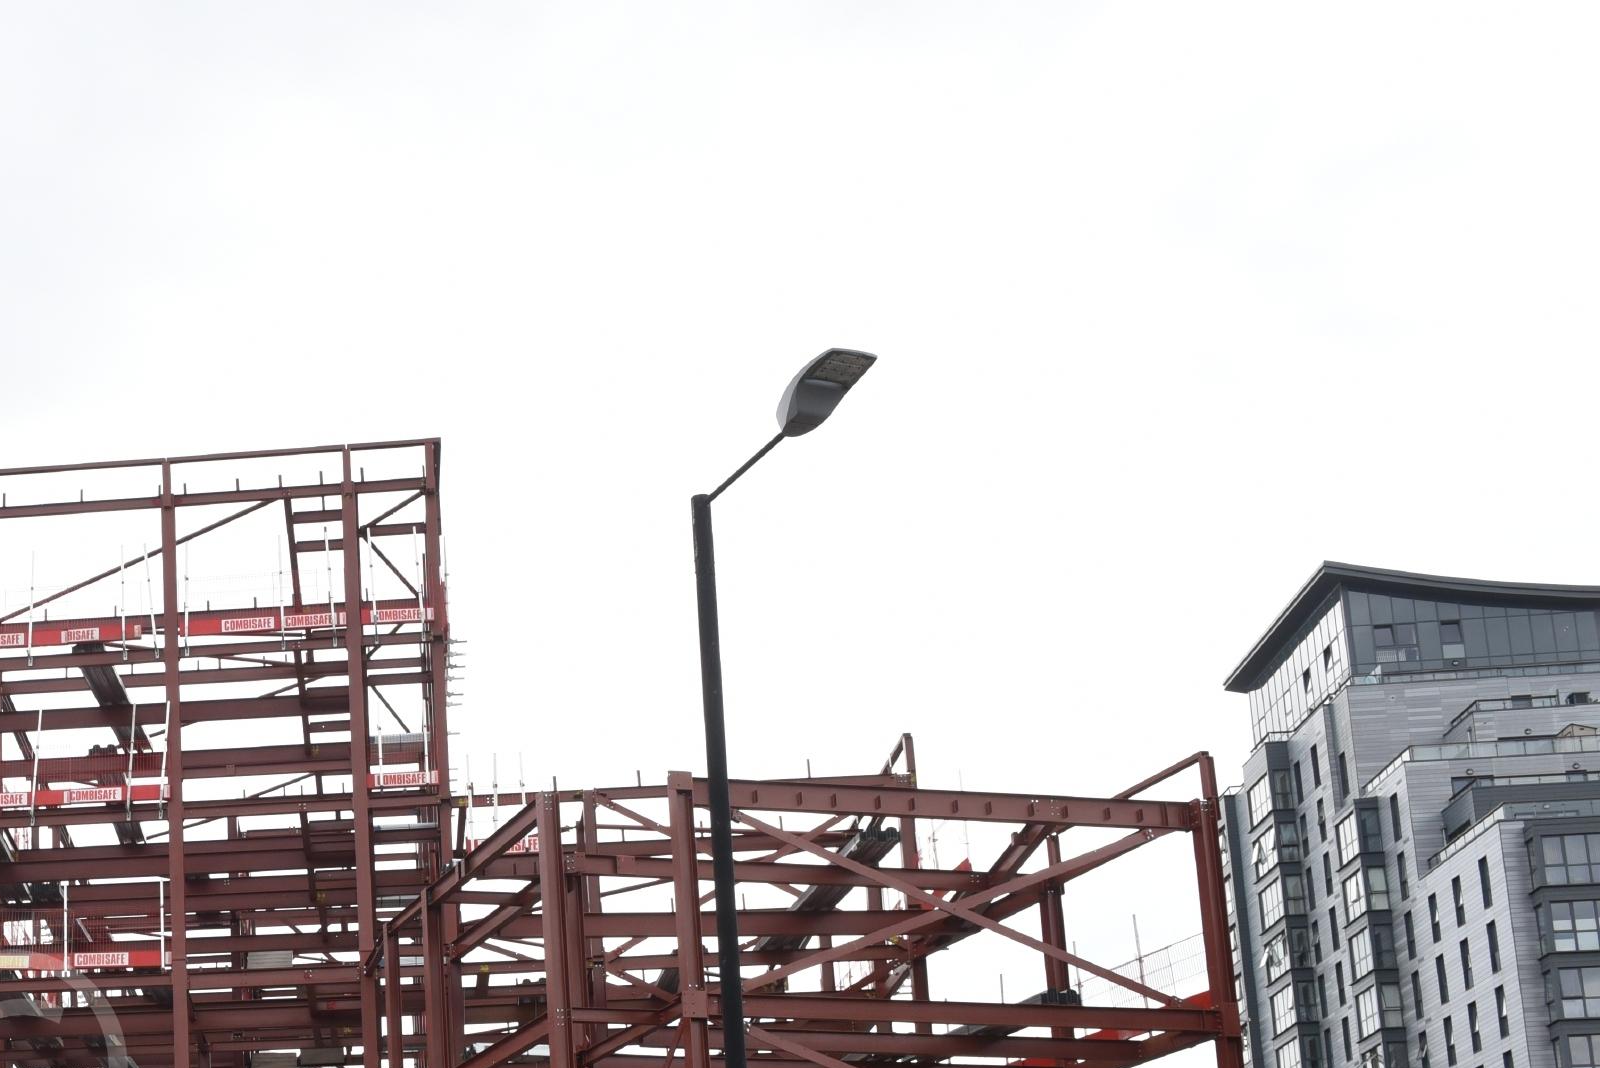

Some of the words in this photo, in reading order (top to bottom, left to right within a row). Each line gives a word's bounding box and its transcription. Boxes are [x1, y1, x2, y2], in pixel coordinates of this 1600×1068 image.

[223, 618, 272, 630] COMBISAFE
[285, 615, 333, 628] COMBISAFE
[70, 789, 118, 800] COMBISAFE
[76, 953, 126, 965] COMBISAFE
